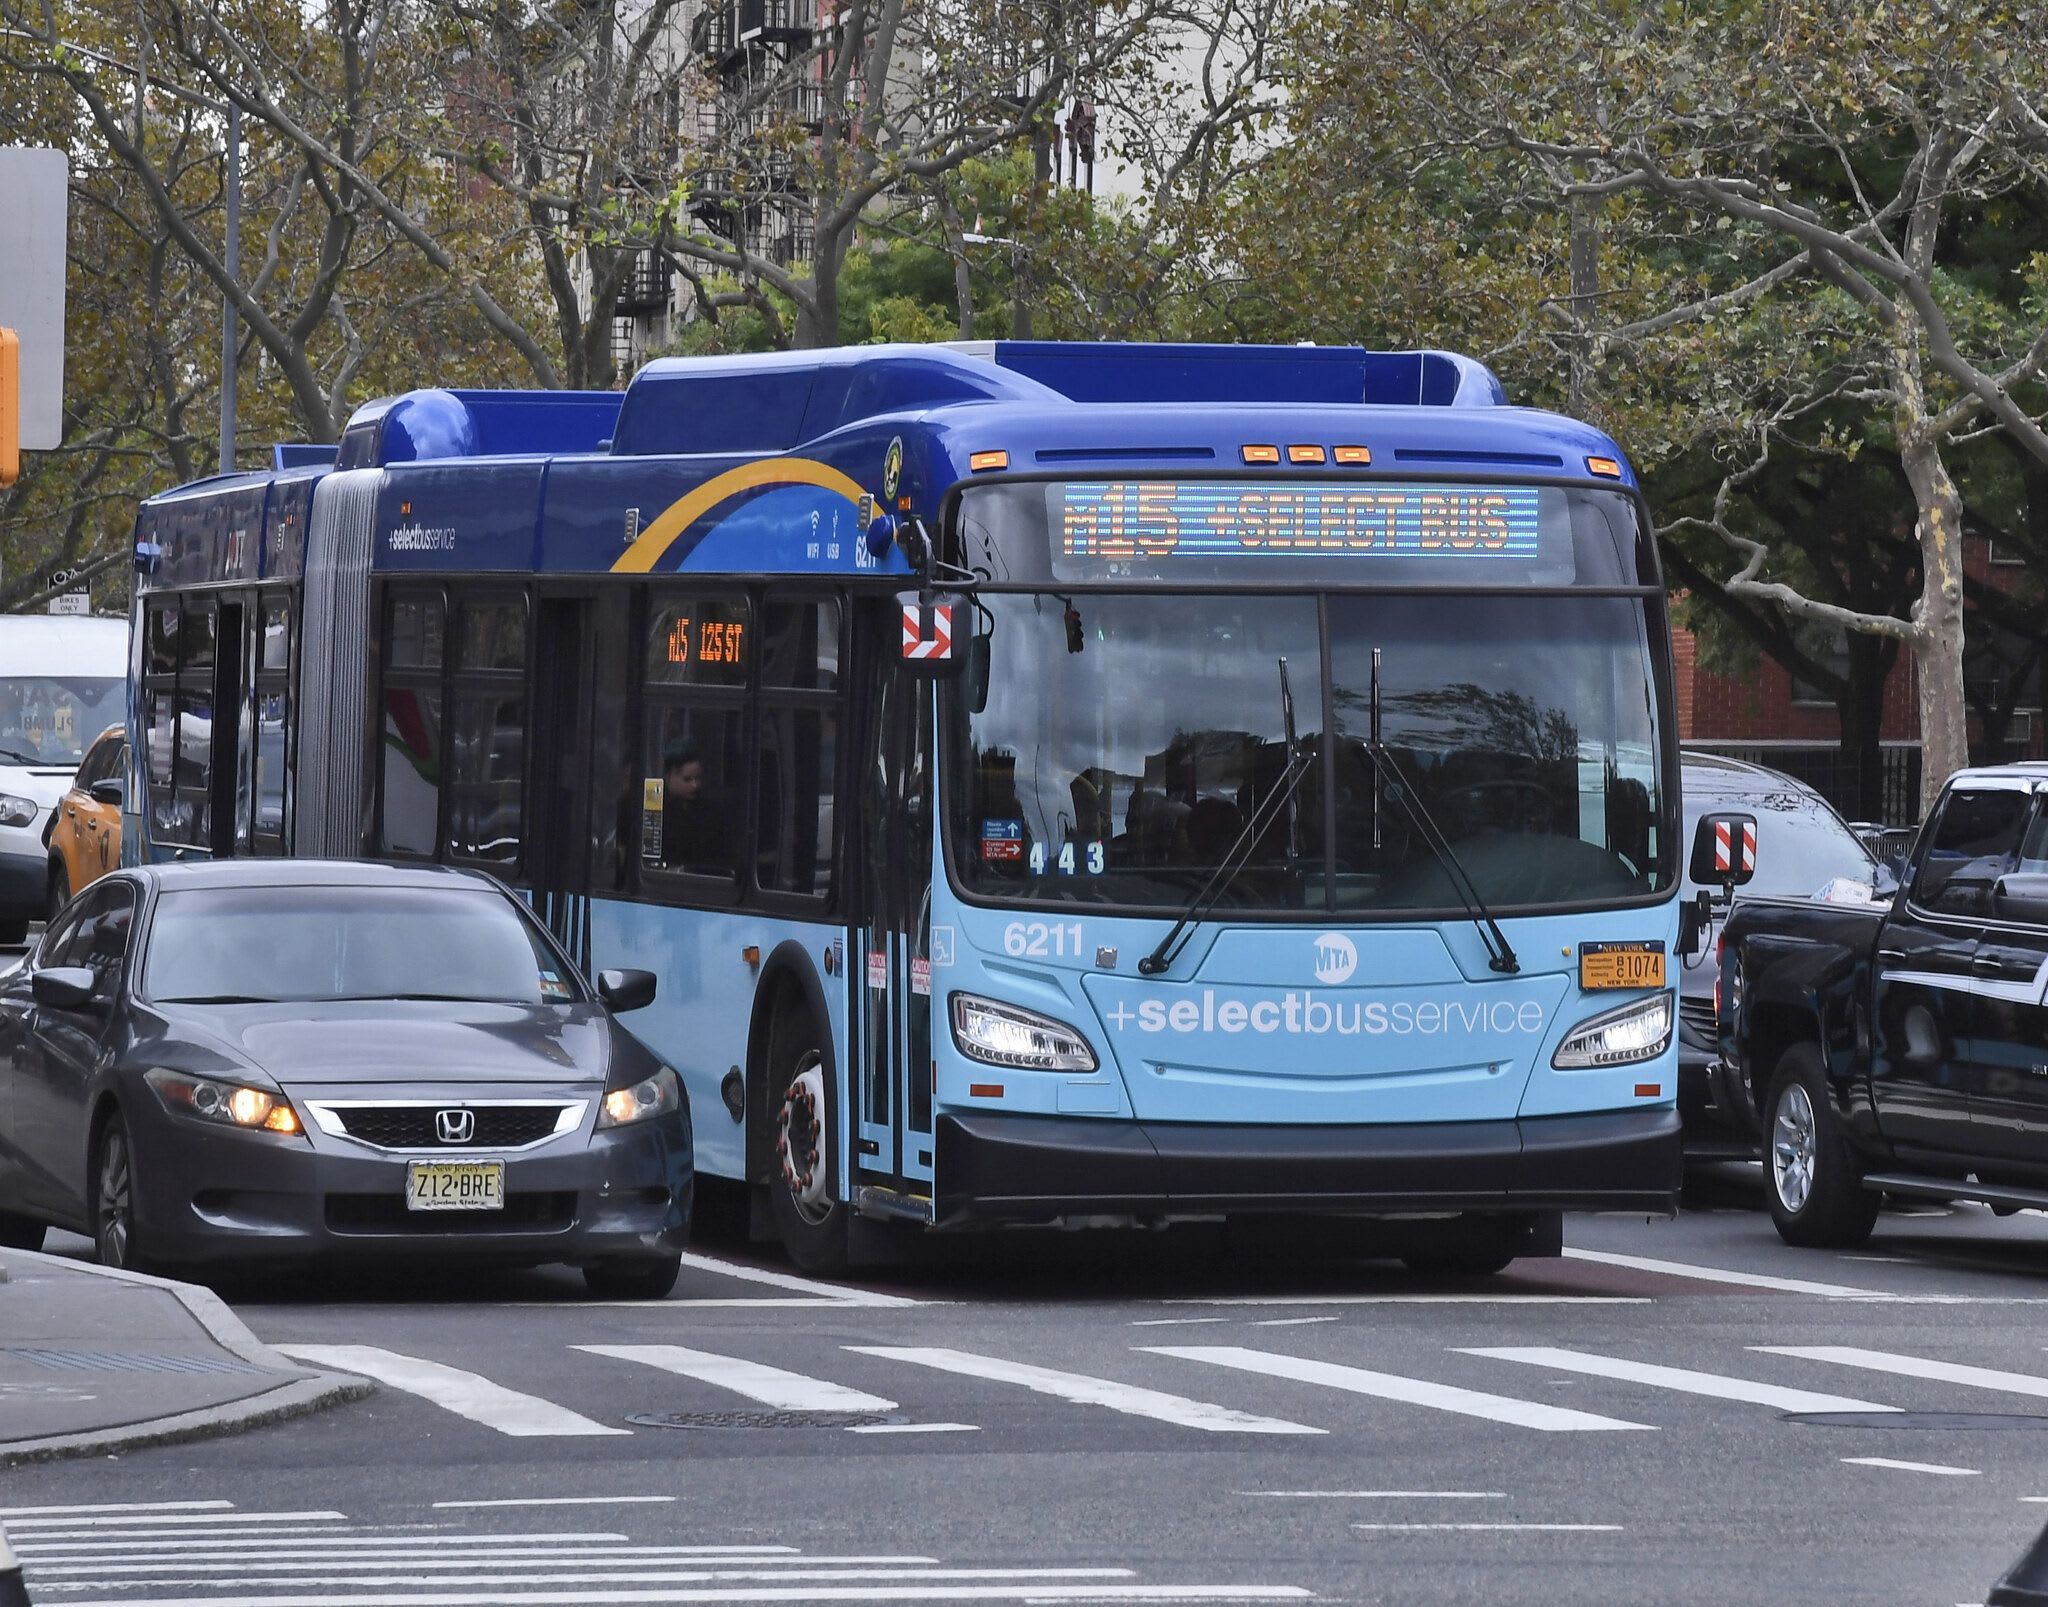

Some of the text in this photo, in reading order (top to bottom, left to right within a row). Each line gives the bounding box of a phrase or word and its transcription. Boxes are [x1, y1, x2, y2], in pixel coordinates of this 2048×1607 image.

[1064, 484, 1178, 555] M15
[1422, 495, 1508, 549] BUS
[827, 543, 840, 560] USB
[668, 618, 743, 662] M15 125 ST
[1004, 922, 1082, 956] 6211
[1603, 943, 1645, 953] NEW YORK
[1313, 942, 1351, 973] MTA
[1627, 956, 1659, 978] 1074
